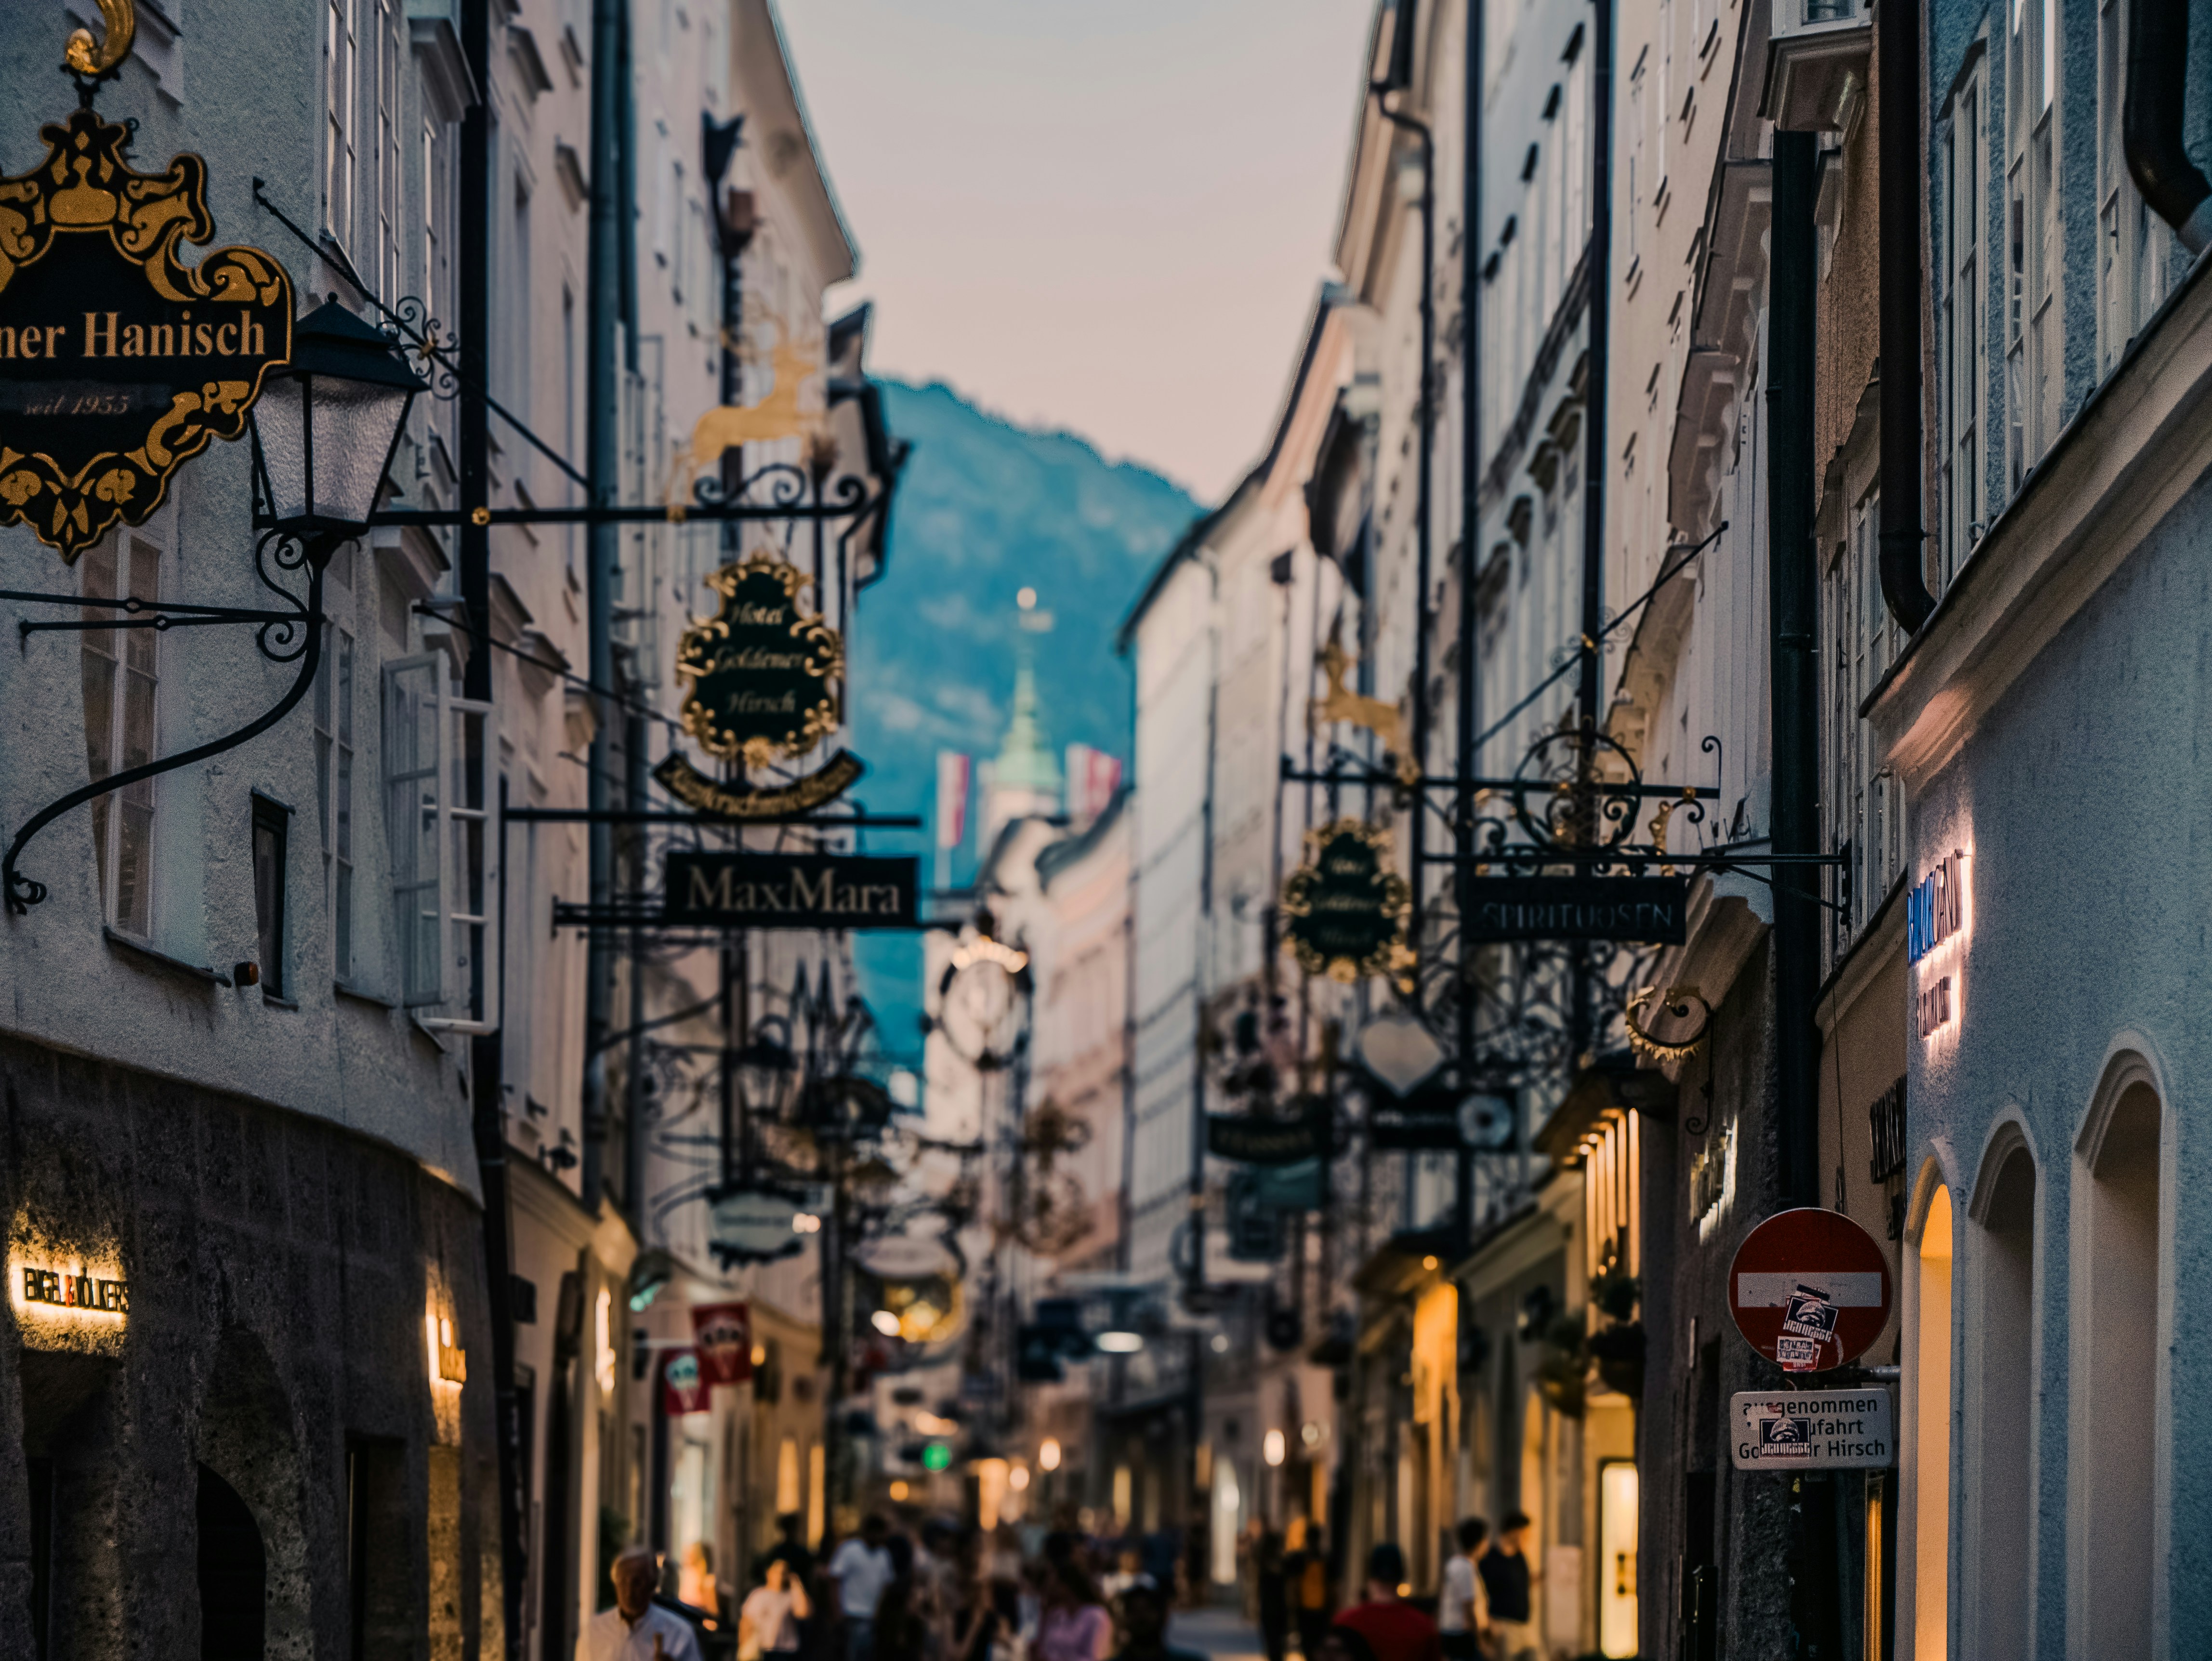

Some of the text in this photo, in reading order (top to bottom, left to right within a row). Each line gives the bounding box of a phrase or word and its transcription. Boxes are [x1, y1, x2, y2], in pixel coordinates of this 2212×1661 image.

[0, 310, 266, 358] ner Hanisch
[71, 395, 130, 415] 1955
[731, 601, 789, 625] Hotel
[715, 646, 804, 672] Goldener
[727, 690, 796, 713] Hirsch
[685, 866, 900, 913] MaxMara
[1482, 902, 1672, 929] SPIRITUOSEN
[1743, 1399, 1878, 1417] agenommen
[1810, 1419, 1864, 1435] fahrt
[1828, 1440, 1885, 1457] Hirsch
